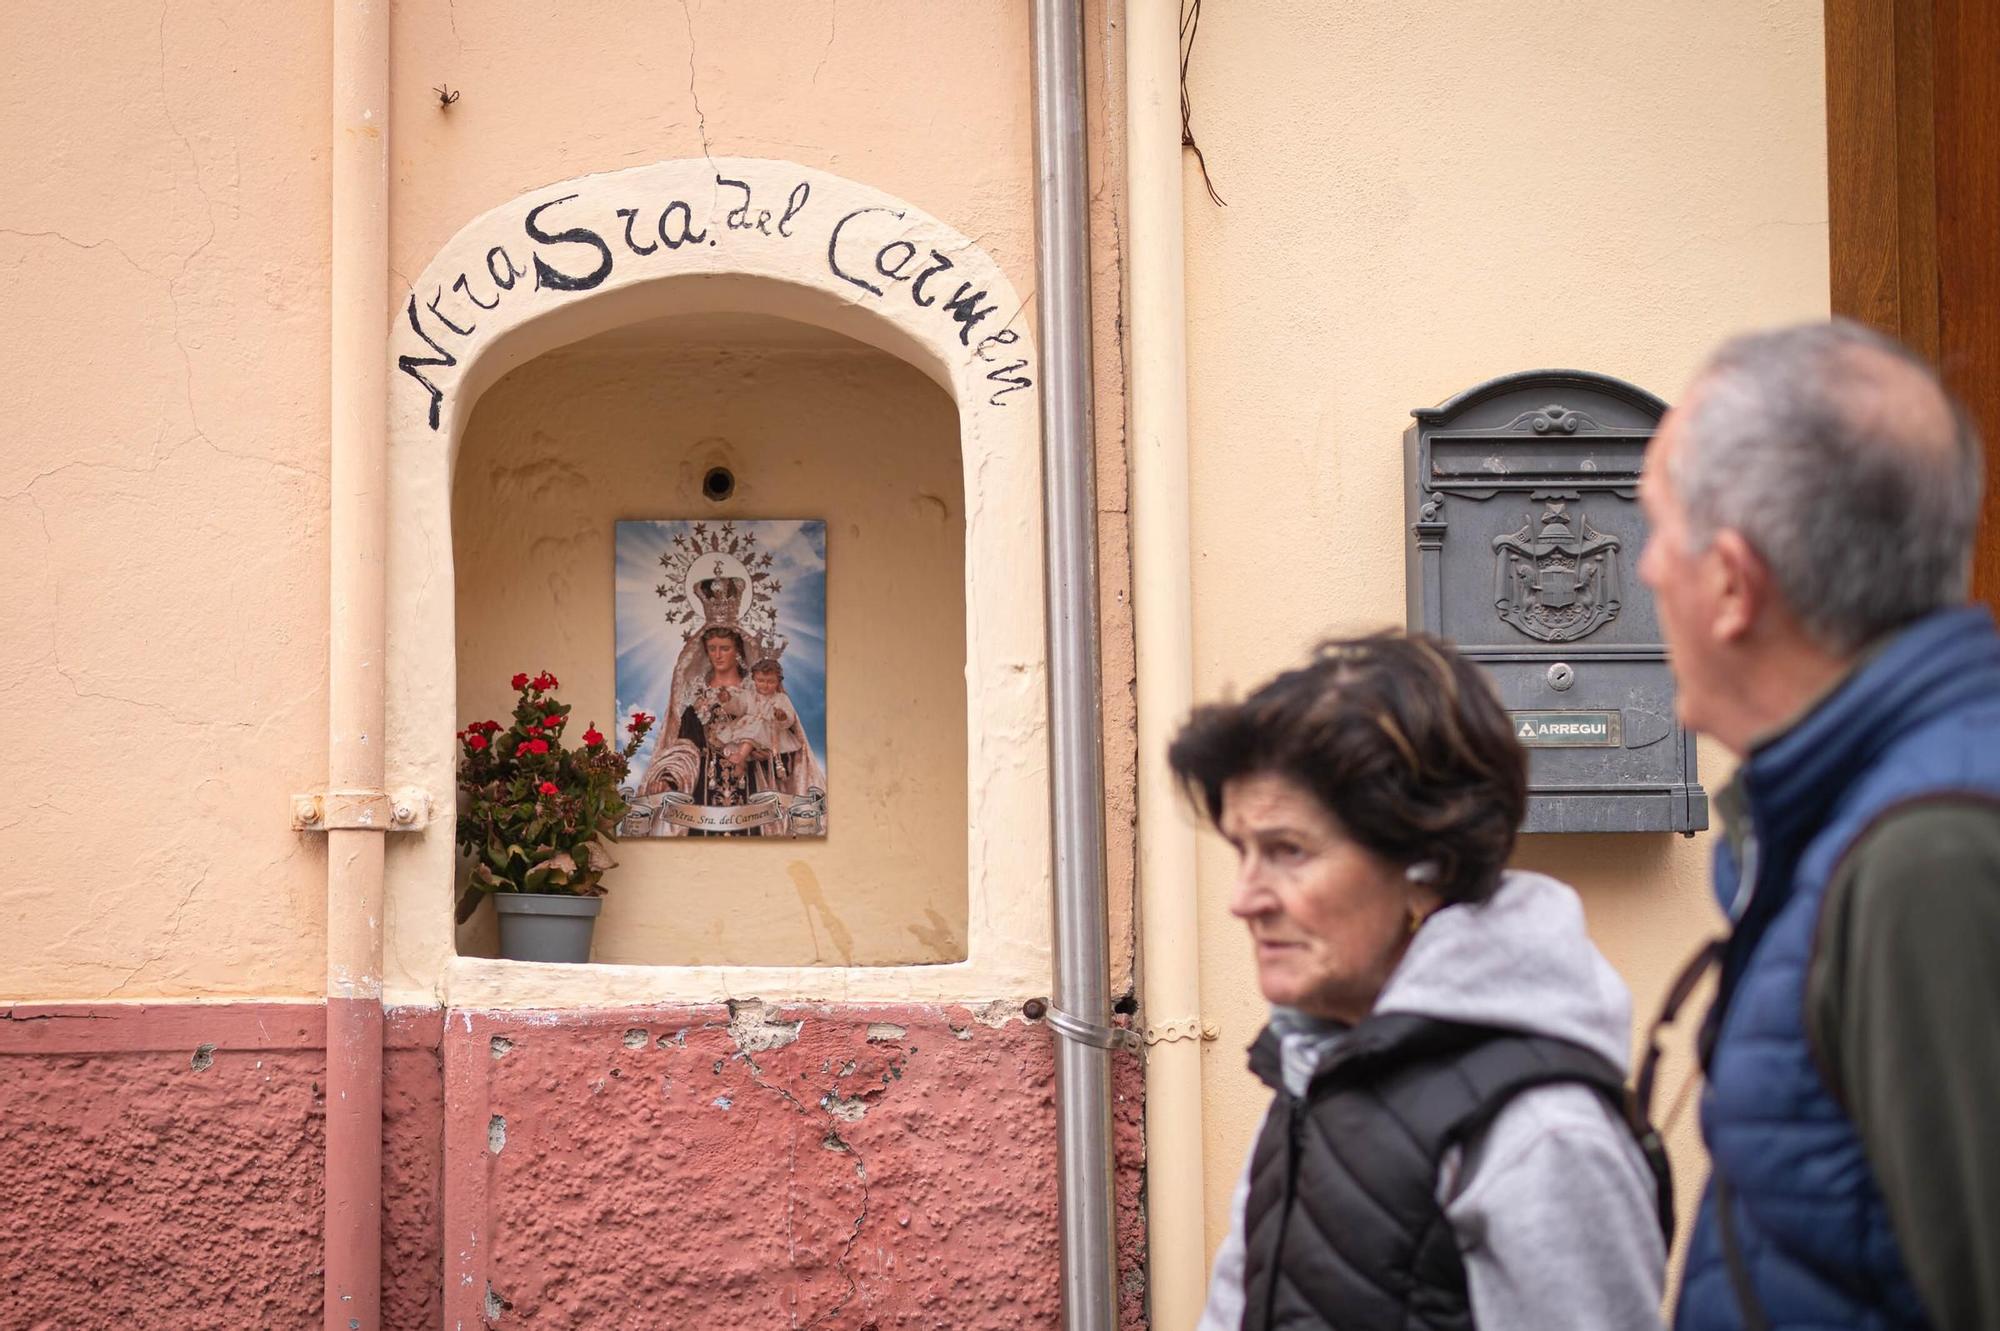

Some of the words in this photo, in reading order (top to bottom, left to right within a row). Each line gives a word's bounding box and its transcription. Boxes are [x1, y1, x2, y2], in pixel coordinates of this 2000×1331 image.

[398, 244, 527, 431] Ntra
[524, 193, 717, 293] Sra.
[716, 173, 810, 238] del
[827, 207, 1033, 408] Carmen
[1538, 723, 1607, 735] ARREGUI
[671, 810, 695, 823] Ntra.
[698, 815, 717, 825] Sra.
[719, 814, 733, 825] del
[735, 810, 770, 825] Carmen
